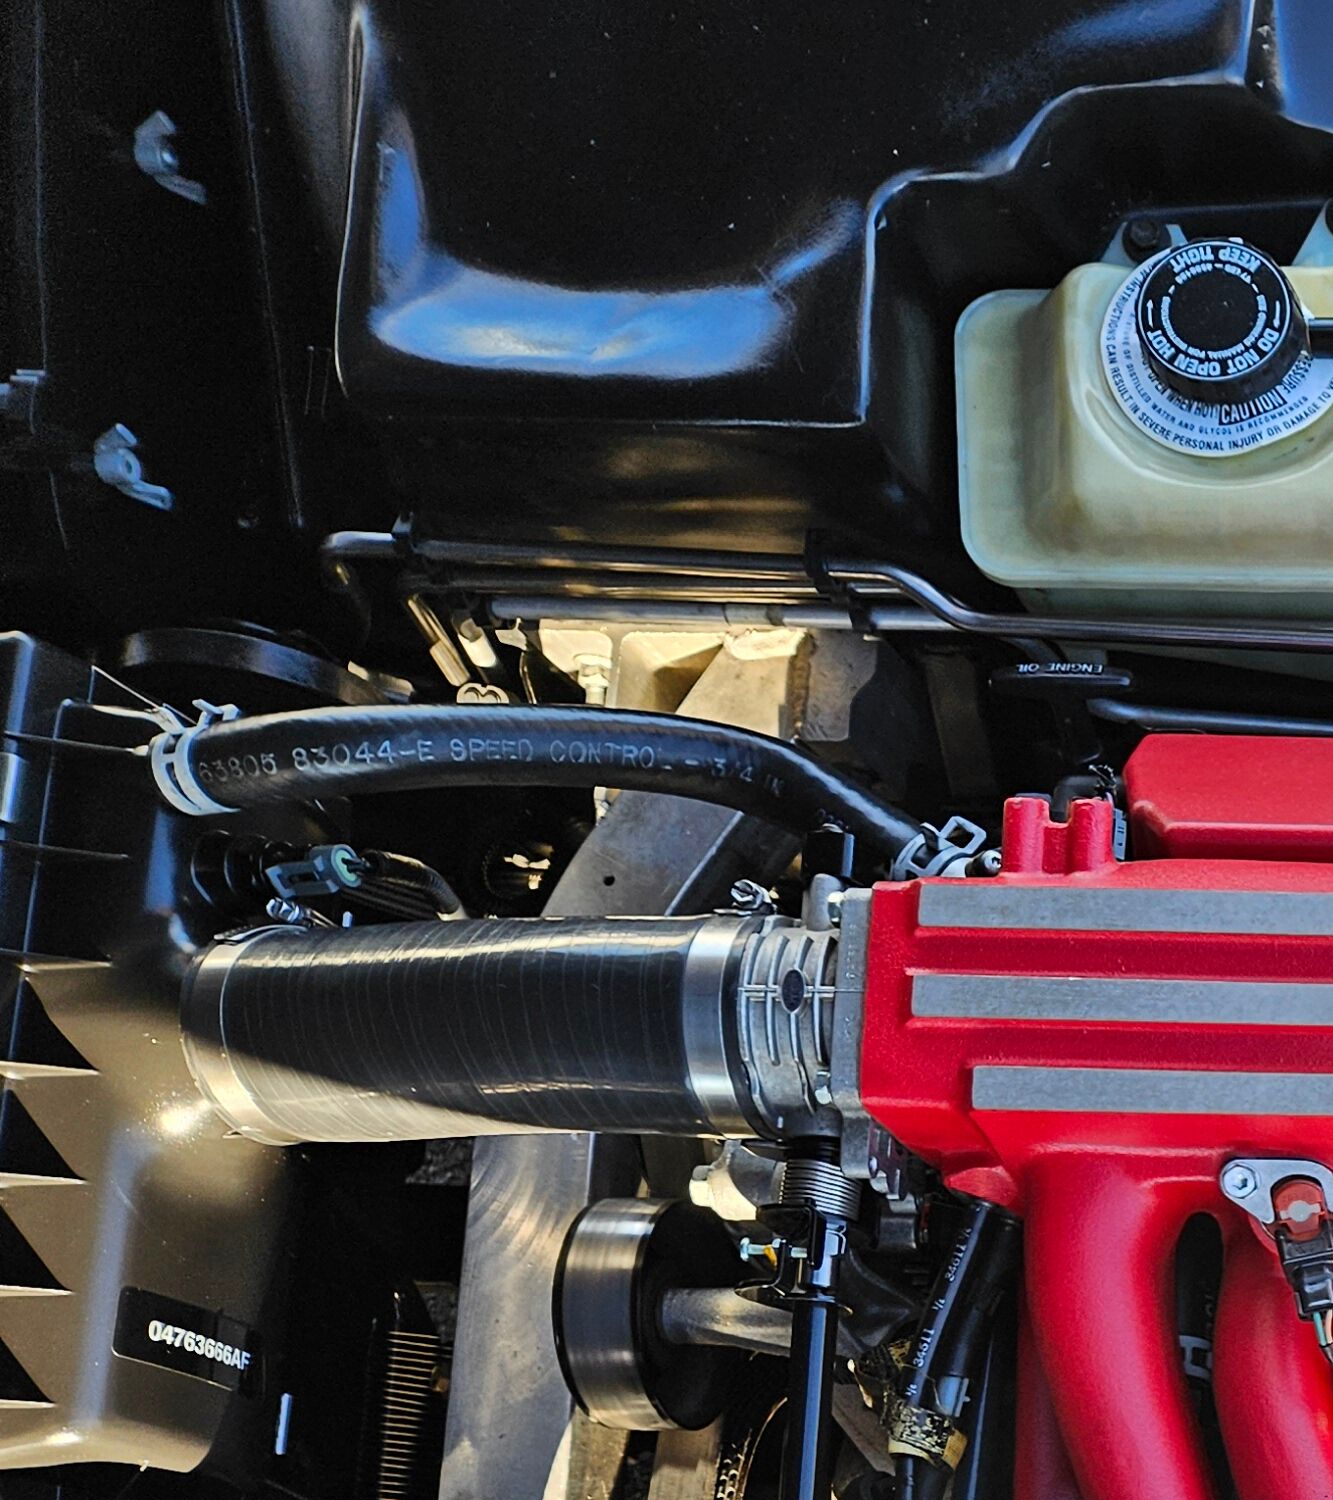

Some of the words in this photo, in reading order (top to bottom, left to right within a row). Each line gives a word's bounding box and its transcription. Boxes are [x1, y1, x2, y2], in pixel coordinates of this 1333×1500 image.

[1169, 245, 1215, 274] TIGHT
[1218, 246, 1262, 273] KEEP
[1105, 276, 1145, 343] INSTRUCTIONS
[1146, 329, 1175, 360] HOT
[1257, 328, 1280, 353] DO
[1106, 343, 1116, 365] CAN
[1174, 354, 1221, 377] OPEN
[1227, 349, 1260, 374] NOT
[1110, 367, 1133, 403] RESULT
[1320, 391, 1331, 405] TO
[1126, 363, 1152, 403] DISTILLED
[1151, 404, 1175, 424] WATER
[1178, 420, 1194, 432] AND
[1199, 425, 1232, 435] GLYCOL
[1249, 396, 1308, 430] RECOMMENDED
[1128, 400, 1138, 414] IN
[1221, 391, 1282, 425] CAUTION
[1138, 412, 1171, 441] SEVERE
[1284, 402, 1321, 430] DAMAGE
[1173, 433, 1225, 450] PERSONAL
[1229, 434, 1264, 450] INJURY
[1267, 424, 1282, 436] OR
[1016, 663, 1039, 673] OIL
[1046, 663, 1103, 673] ENGINE
[291, 739, 435, 772] 83044-E
[449, 738, 534, 763] SPEED
[148, 1319, 252, 1371] 04763666AF
